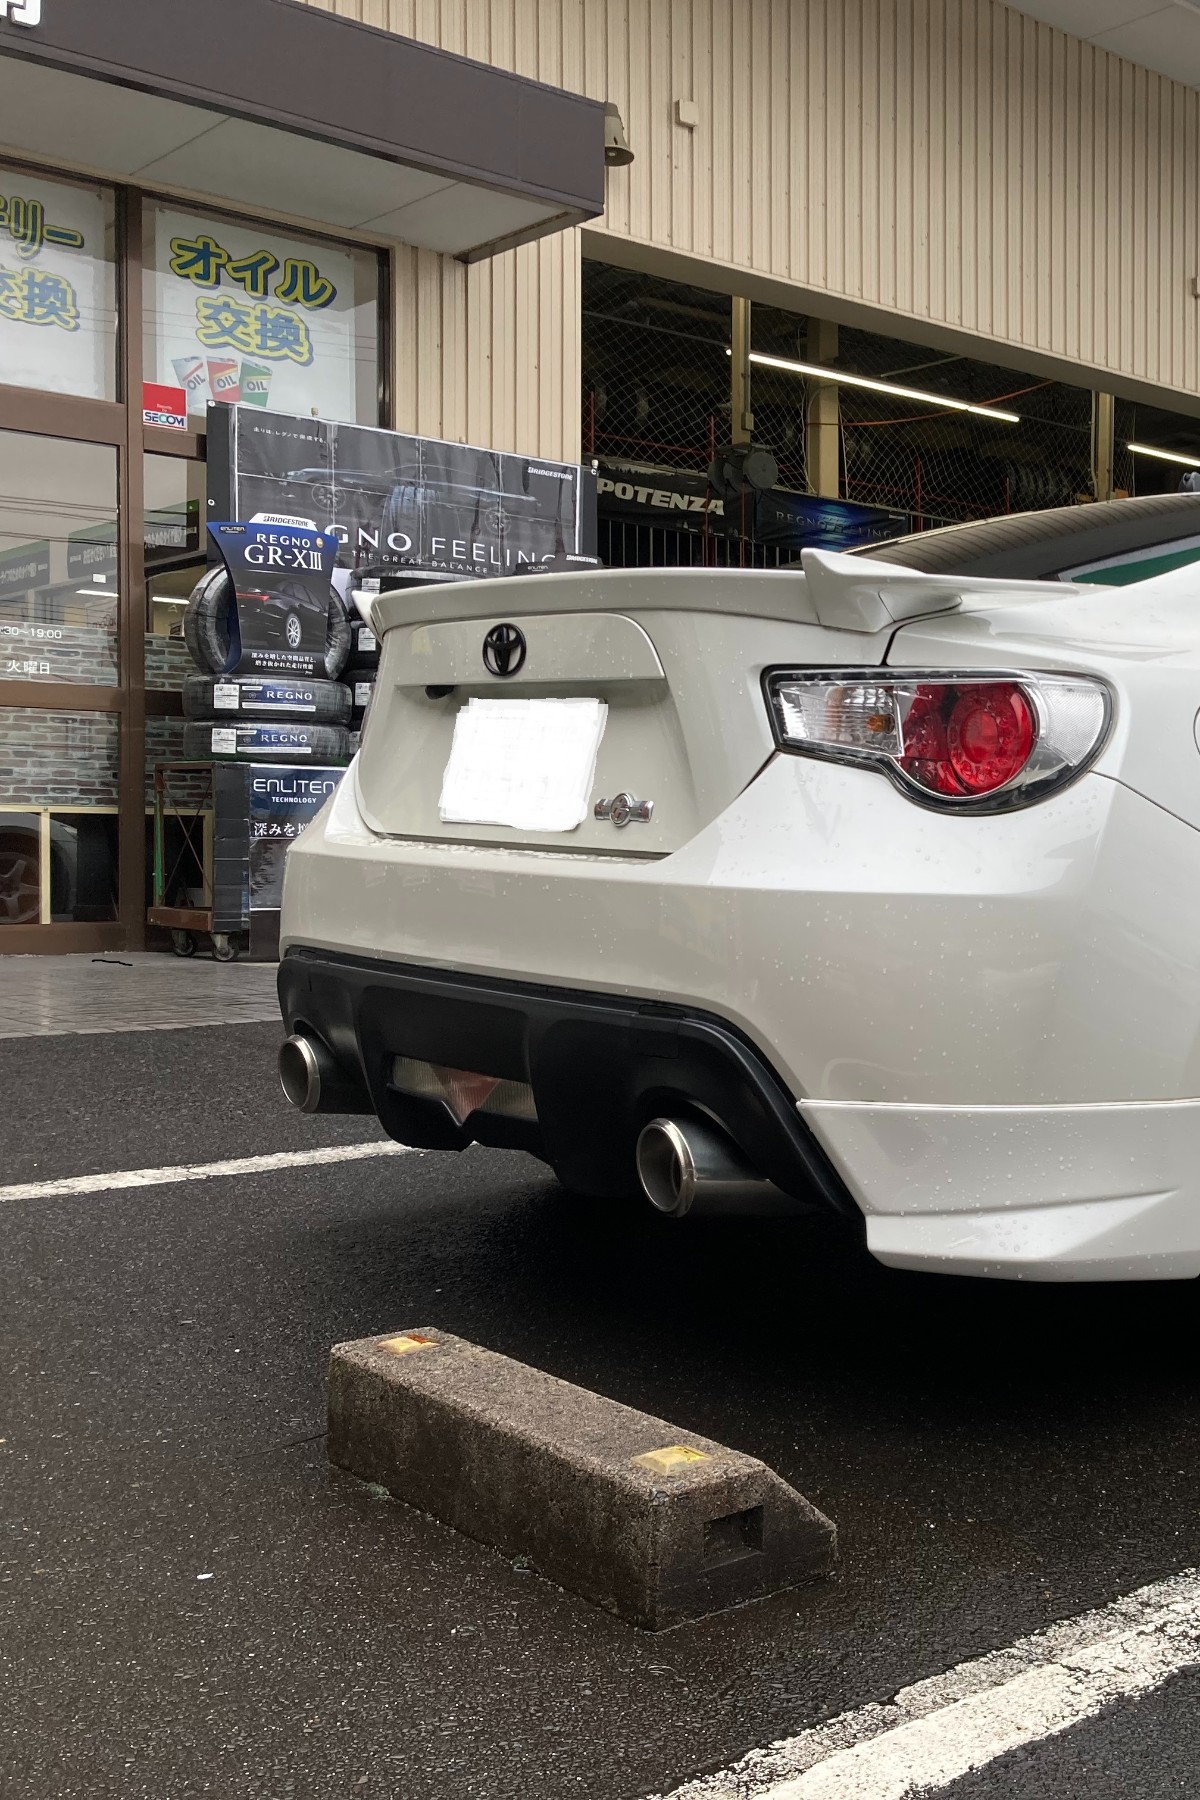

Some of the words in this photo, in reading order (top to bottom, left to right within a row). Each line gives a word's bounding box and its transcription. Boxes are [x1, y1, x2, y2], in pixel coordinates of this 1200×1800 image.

[0, 195, 84, 260] リー
[170, 235, 335, 309] オイル
[196, 295, 312, 364] 交換
[187, 374, 206, 390] OIL
[217, 375, 237, 389] OIL
[246, 381, 268, 391] OIL
[145, 411, 185, 426] SECOM
[528, 466, 573, 480] BRIDGESTONE
[596, 477, 725, 516] POTENZA
[264, 515, 309, 527] BRIDGESTONE
[776, 511, 827, 530] REGNO
[256, 533, 311, 548] REGNO
[352, 550, 374, 560] THE
[382, 555, 423, 566] GREAT
[431, 560, 488, 574] BALANCE
[7, 659, 50, 674] 火曜日
[266, 690, 313, 700] REGNO
[261, 734, 308, 742] REGNO
[253, 778, 335, 794] ENLITEN
[271, 796, 317, 804] TECHNOLOGY
